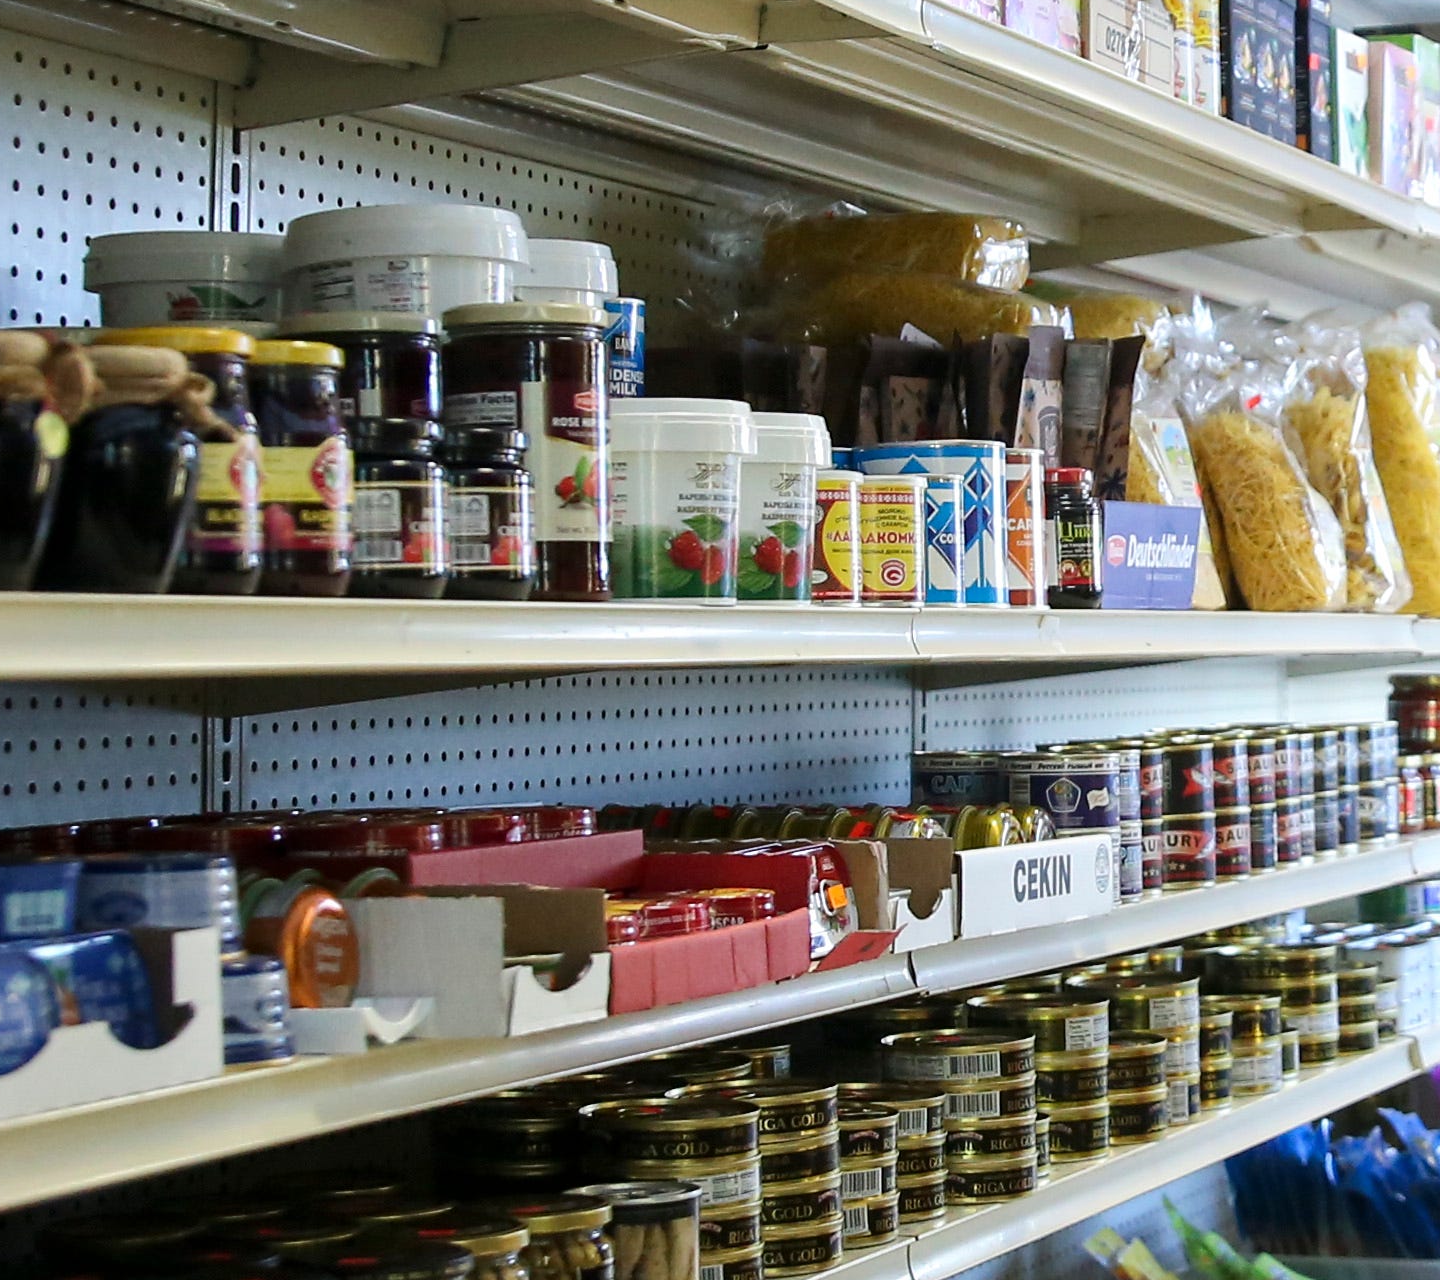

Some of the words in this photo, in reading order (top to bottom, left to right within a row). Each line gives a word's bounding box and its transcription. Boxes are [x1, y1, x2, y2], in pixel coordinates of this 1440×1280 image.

[610, 383, 638, 397] MILK
[1127, 533, 1195, 568] Deutschländer
[1162, 830, 1203, 849] URY
[1013, 854, 1072, 904] CEKIN
[791, 1111, 825, 1129] GOLD
[663, 1141, 710, 1158] GOLD
[991, 1135, 1018, 1150] RIGA
[973, 1179, 1005, 1195] RIGA
[904, 1194, 933, 1210] RIGA
[772, 1203, 813, 1220] GOLD
[790, 1246, 826, 1264] GOLD
